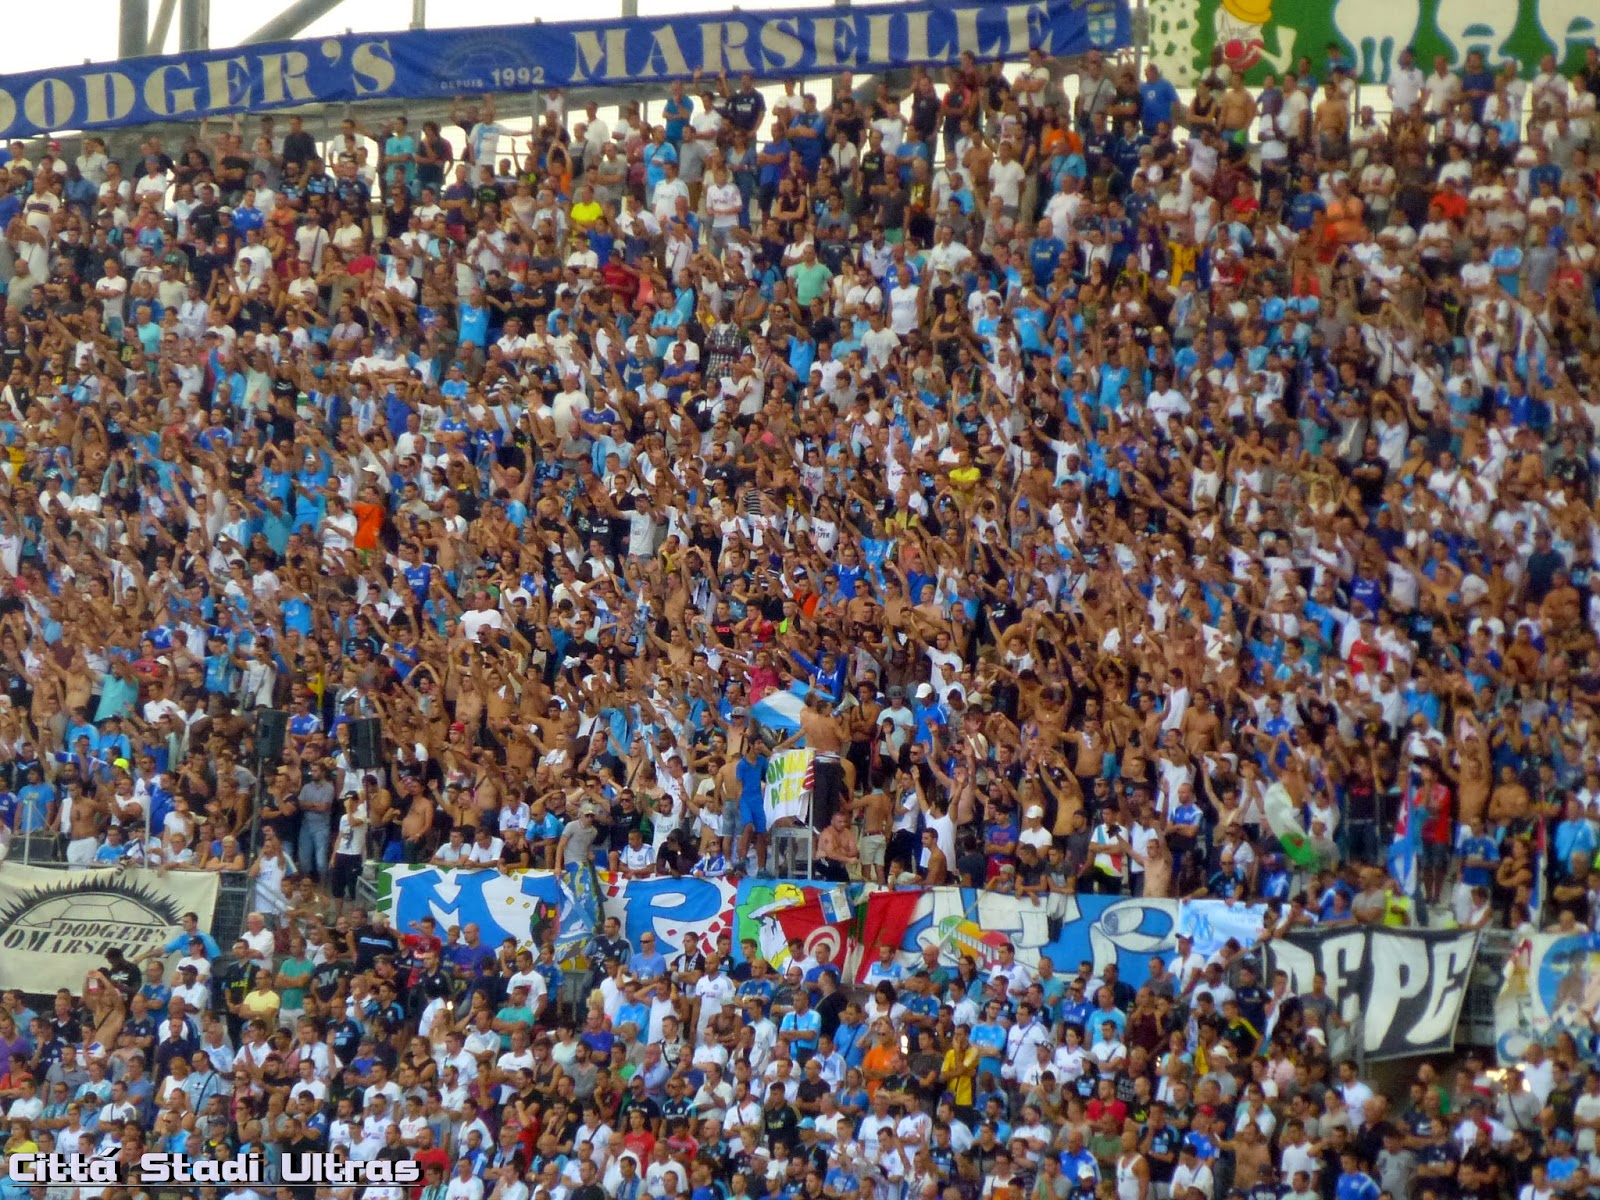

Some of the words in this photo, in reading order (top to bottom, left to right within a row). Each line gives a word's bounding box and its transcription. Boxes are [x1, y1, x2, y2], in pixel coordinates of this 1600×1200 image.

[440, 79, 484, 91] DEPUIS
[491, 66, 546, 87] 1992
[570, 2, 1055, 82] MARSEILLE
[52, 921, 167, 943] DODGER'S
